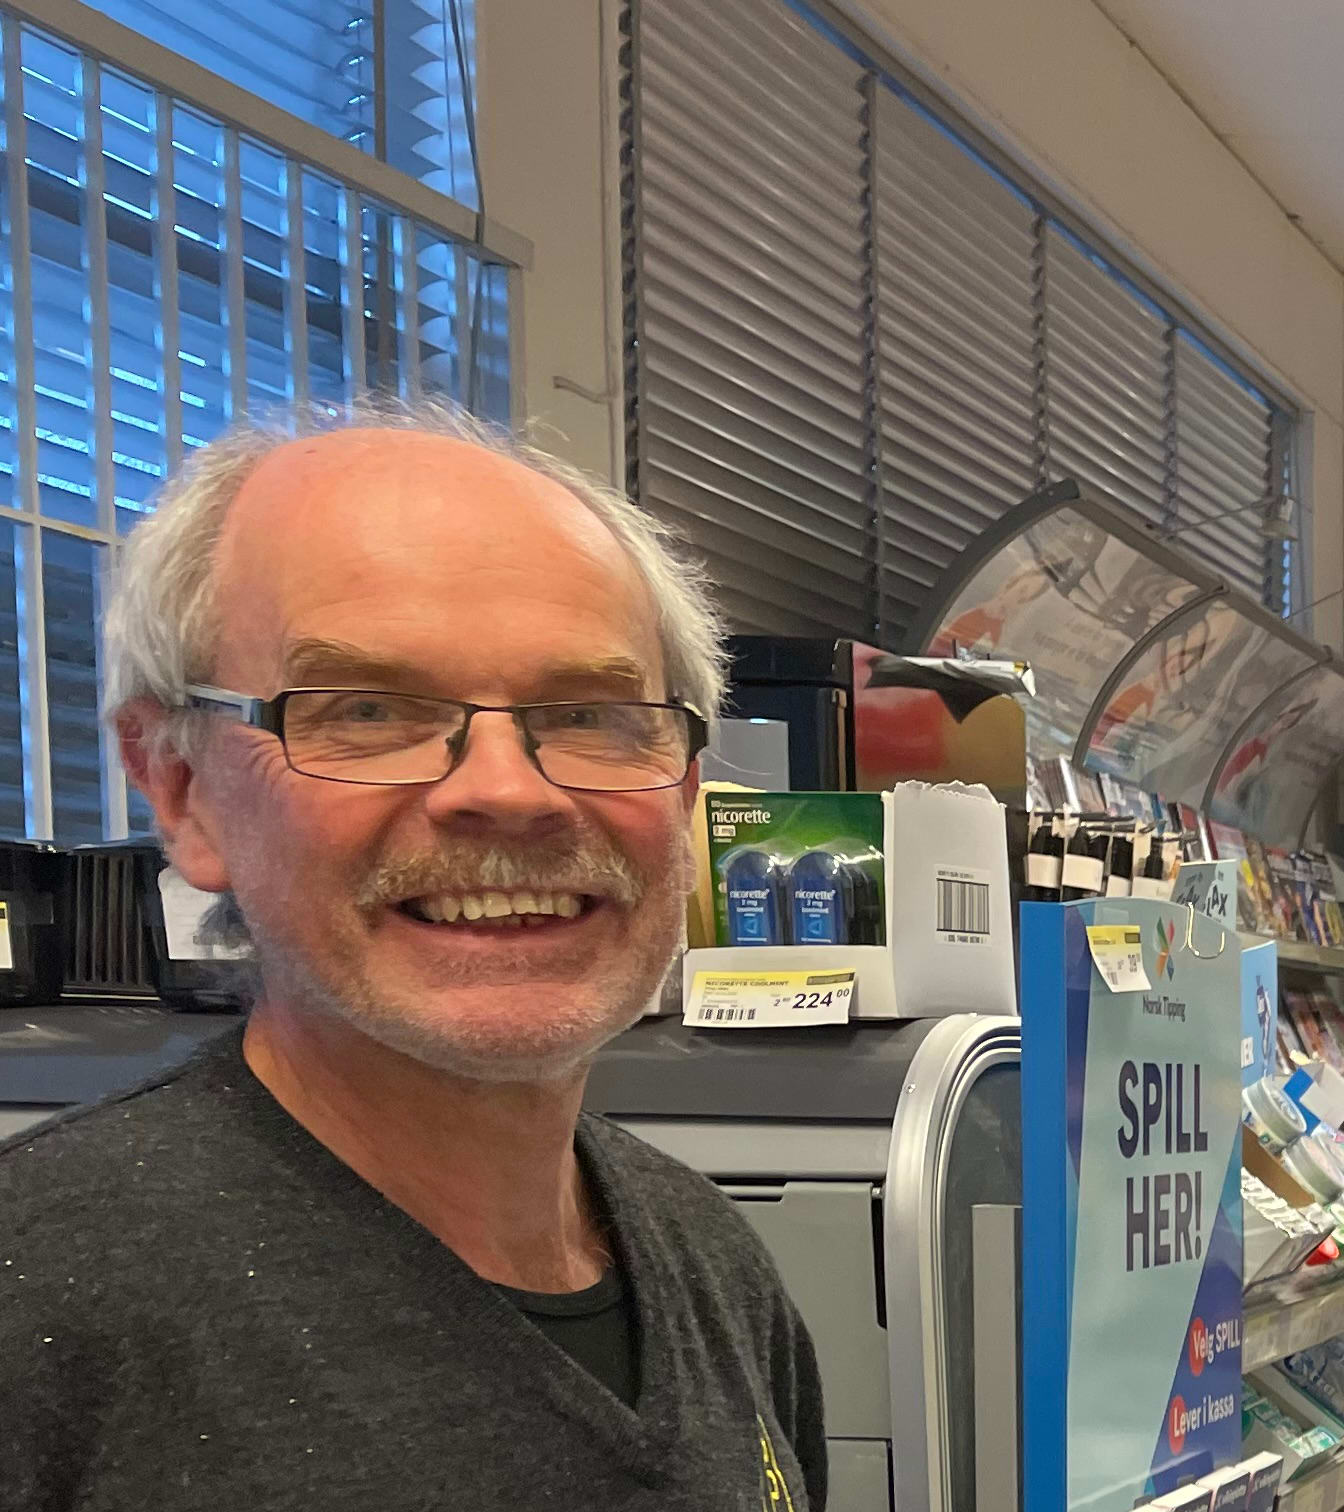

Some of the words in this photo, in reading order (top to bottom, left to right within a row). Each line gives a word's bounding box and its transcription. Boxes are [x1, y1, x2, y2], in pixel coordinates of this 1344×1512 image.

[711, 808, 772, 824] nicorette
[792, 991, 833, 1010] 224
[836, 988, 850, 998] 00
[1142, 995, 1162, 1015] Norsk
[1162, 998, 1186, 1023] Tipping
[1117, 1059, 1209, 1159] SPILL
[1125, 1170, 1203, 1273] HER!
[1193, 1329, 1215, 1364] Velg
[1215, 1318, 1241, 1354] SPILL
[1173, 1404, 1202, 1438] Lever
[1207, 1392, 1235, 1424] kassa
